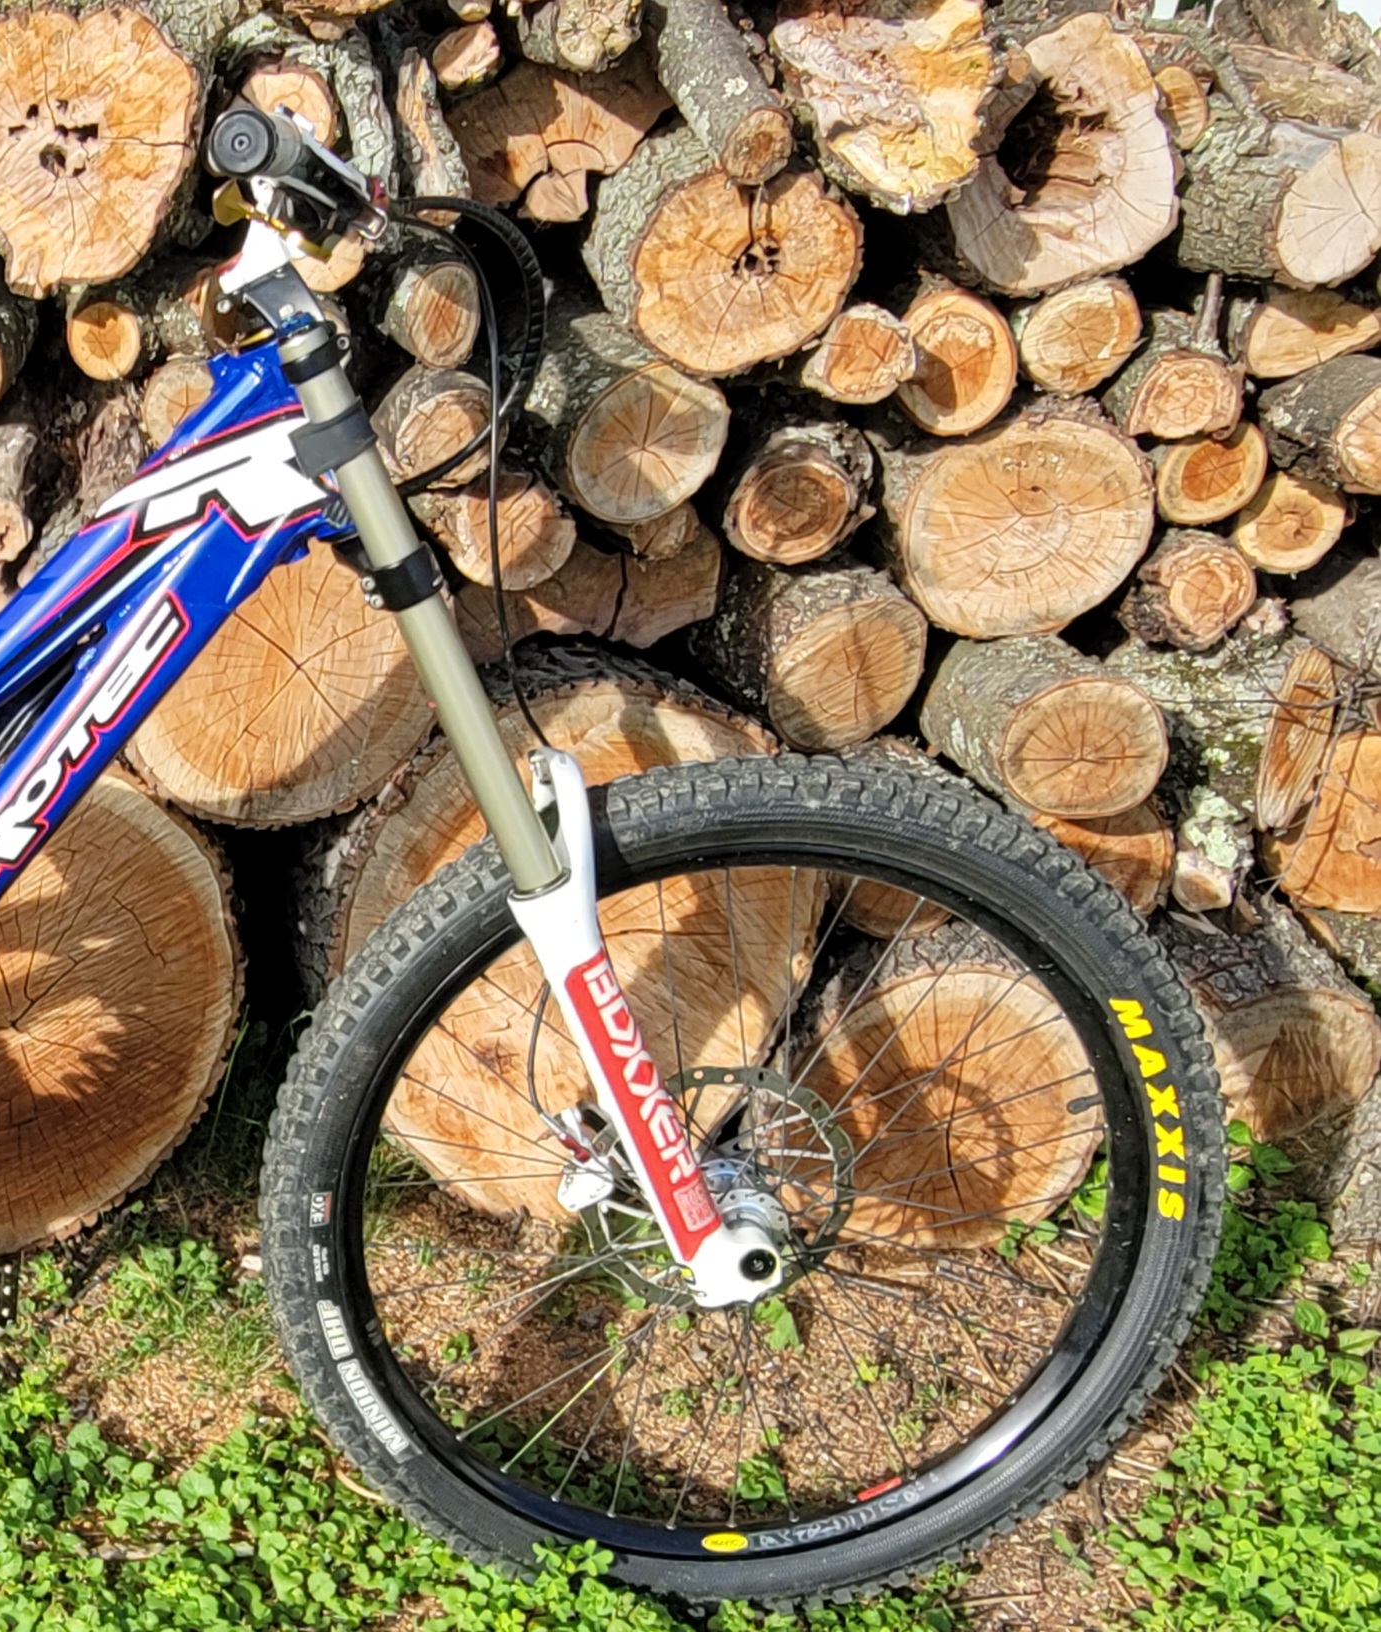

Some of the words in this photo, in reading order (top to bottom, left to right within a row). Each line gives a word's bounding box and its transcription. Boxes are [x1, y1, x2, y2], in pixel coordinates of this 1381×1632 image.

[582, 958, 699, 1185] BOXXER
[1108, 997, 1187, 1221] MAXXIS
[317, 1300, 354, 1361] DHF
[337, 1358, 409, 1455] MINION
